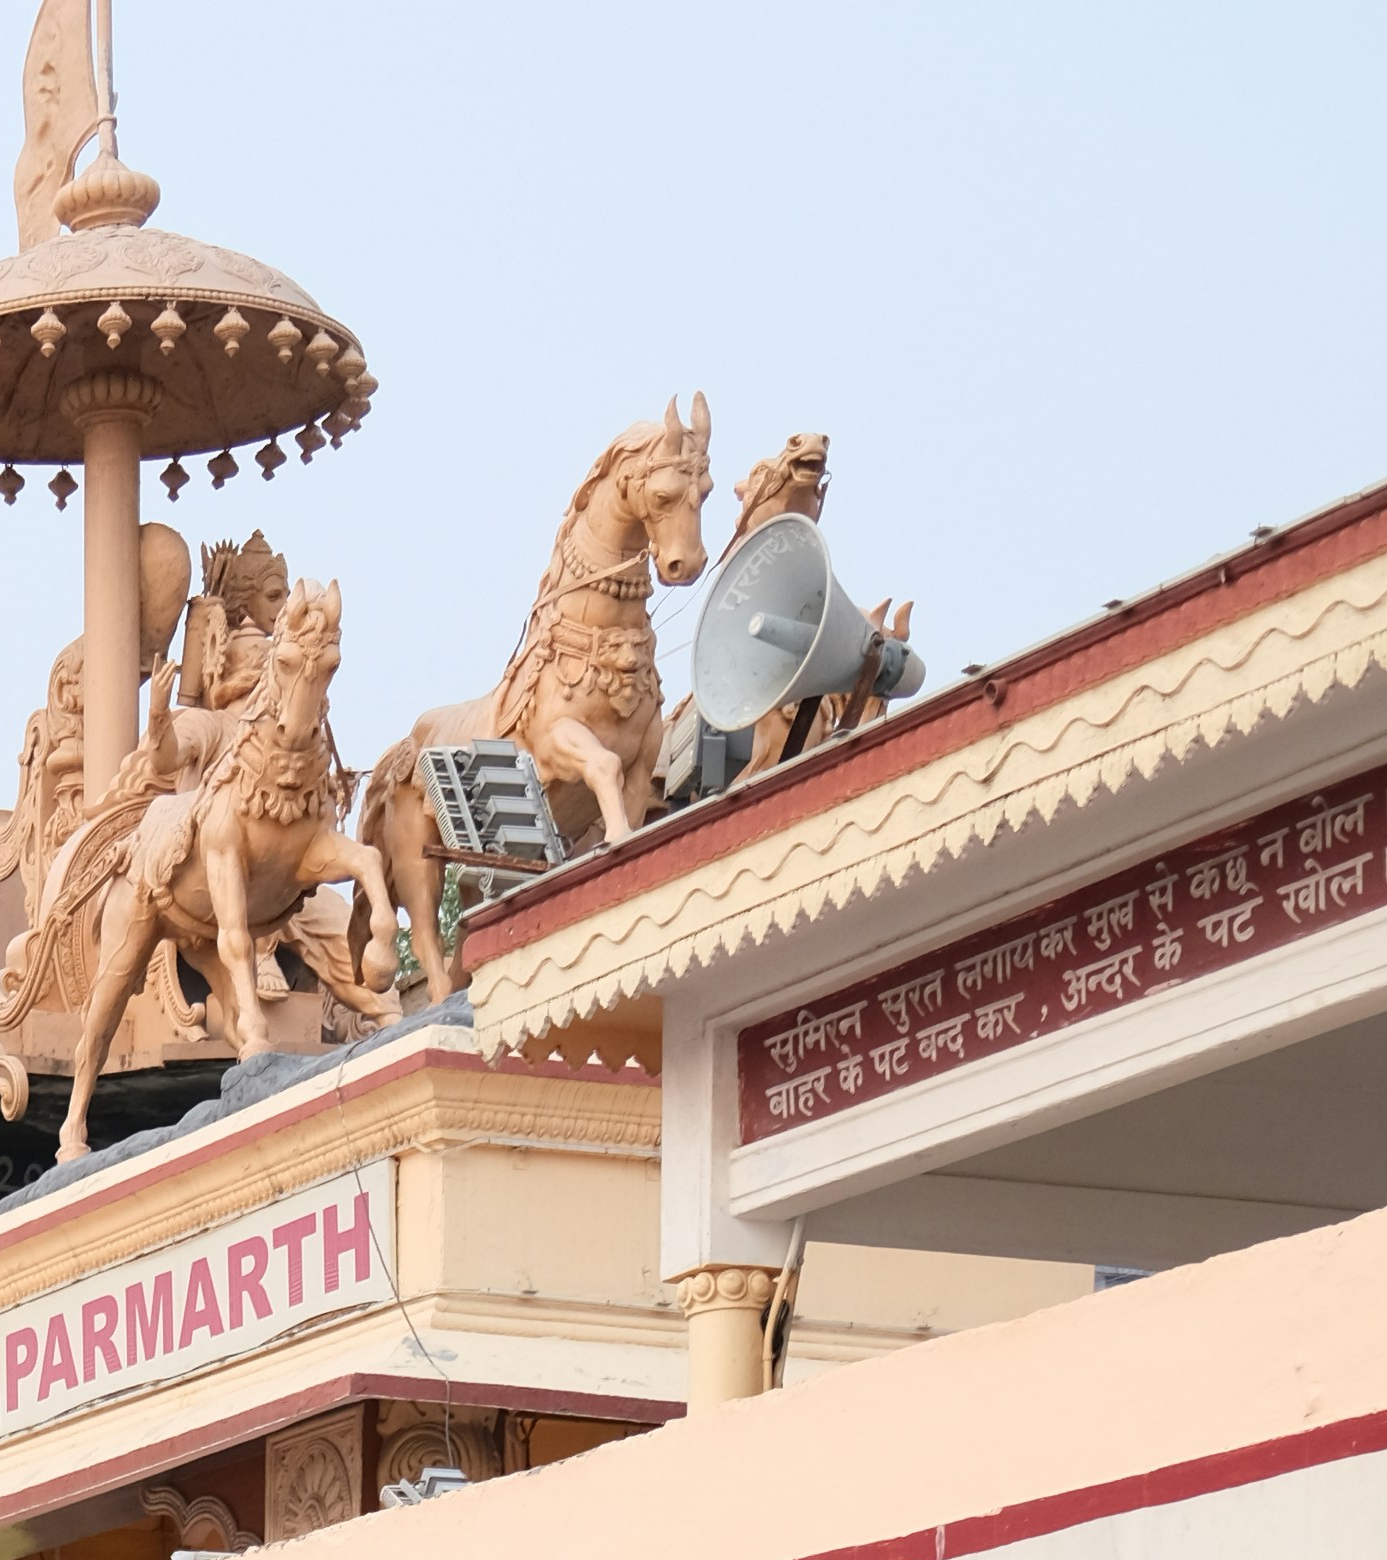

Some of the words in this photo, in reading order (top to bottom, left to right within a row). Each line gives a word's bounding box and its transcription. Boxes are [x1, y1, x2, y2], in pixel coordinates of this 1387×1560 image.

[764, 1000, 868, 1073] सुमिरन
[878, 969, 945, 1034] सुरत
[954, 932, 1037, 999] लगाय
[1039, 916, 1077, 960] कर
[1084, 890, 1140, 950] मुख
[1146, 862, 1179, 919] से
[1257, 827, 1291, 868] न
[1296, 793, 1374, 854] बोल
[765, 1066, 831, 1118] बाहर
[837, 1044, 863, 1094] के
[869, 1037, 910, 1081] पट
[975, 992, 1025, 1040] कर
[1061, 945, 1143, 1012] अन्दर
[1152, 922, 1184, 970] के
[1197, 896, 1263, 947] पट
[1277, 852, 1374, 924] खोल
[5, 1192, 371, 1412] PARMARTH
